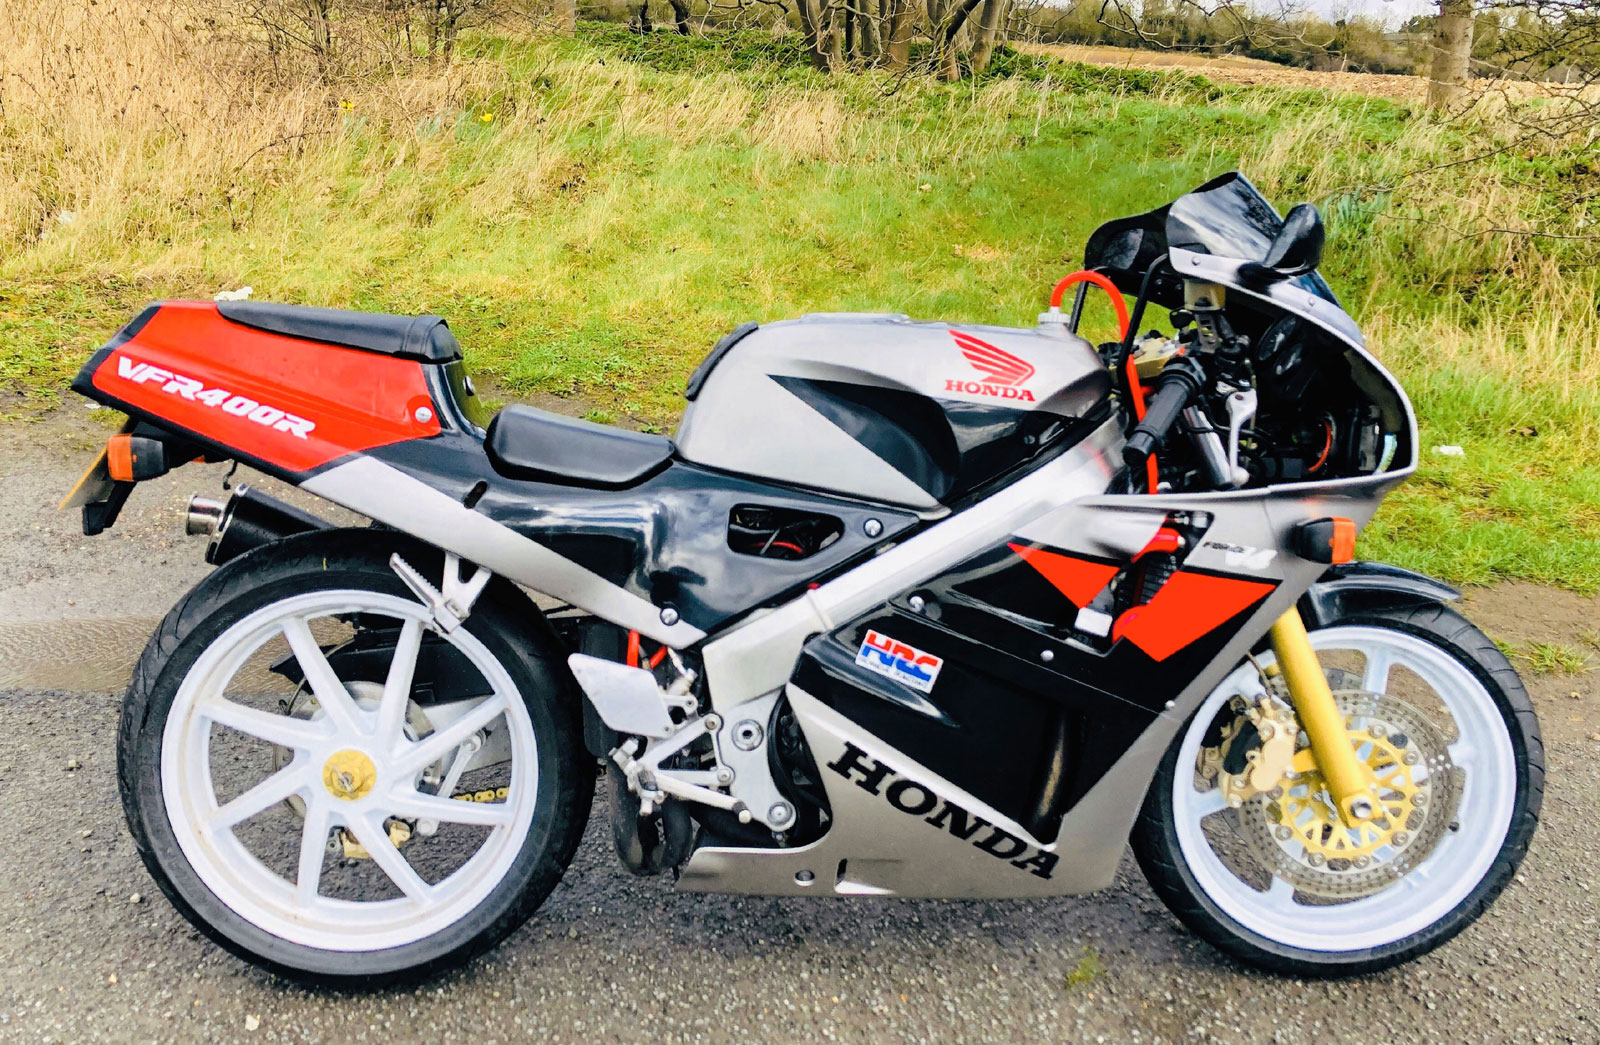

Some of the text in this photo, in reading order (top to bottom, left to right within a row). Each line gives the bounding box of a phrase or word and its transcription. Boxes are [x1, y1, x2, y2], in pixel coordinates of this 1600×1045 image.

[117, 355, 316, 440] VFR400R
[944, 379, 1036, 402] HONDA
[861, 633, 938, 682] HRC
[827, 741, 1060, 880] HONDA
